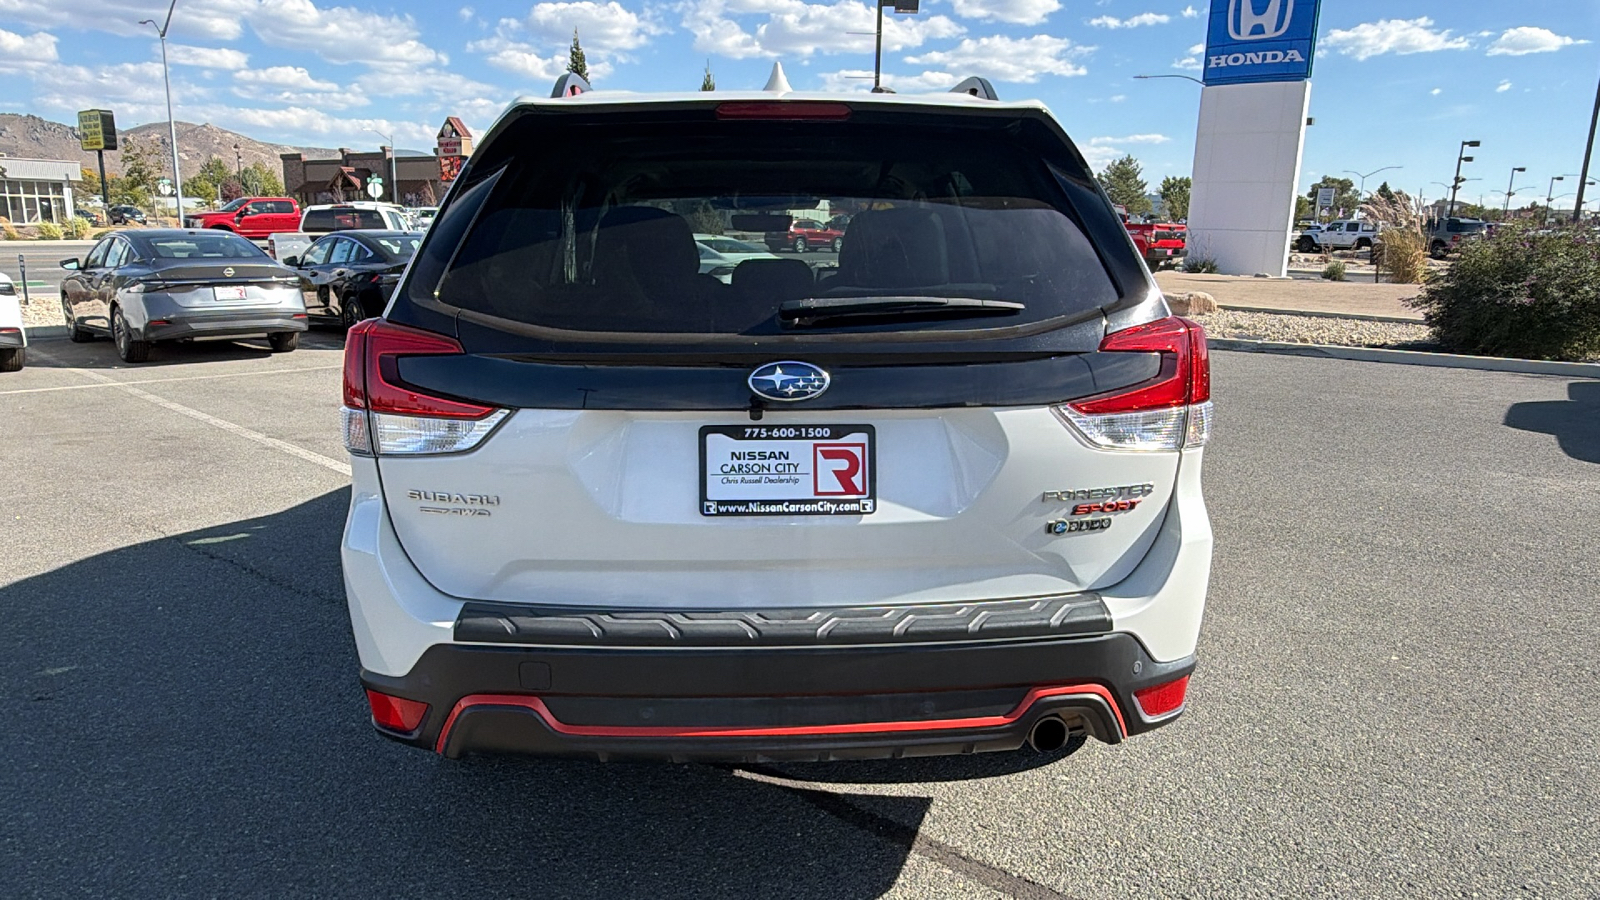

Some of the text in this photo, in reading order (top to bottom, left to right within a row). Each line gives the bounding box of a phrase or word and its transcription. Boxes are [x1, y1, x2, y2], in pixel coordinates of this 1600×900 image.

[1208, 50, 1305, 68] HONDA
[744, 428, 830, 438] 775-600-1500
[731, 451, 789, 461] NISSAN
[720, 463, 800, 474] CARSON CITY
[721, 476, 800, 486] Chris Russell Dealership
[408, 489, 500, 506] SUBARU
[1042, 481, 1154, 502] FORESTER
[718, 502, 860, 514] www.NissanCarsonCity.com
[1071, 499, 1142, 515] SPORT
